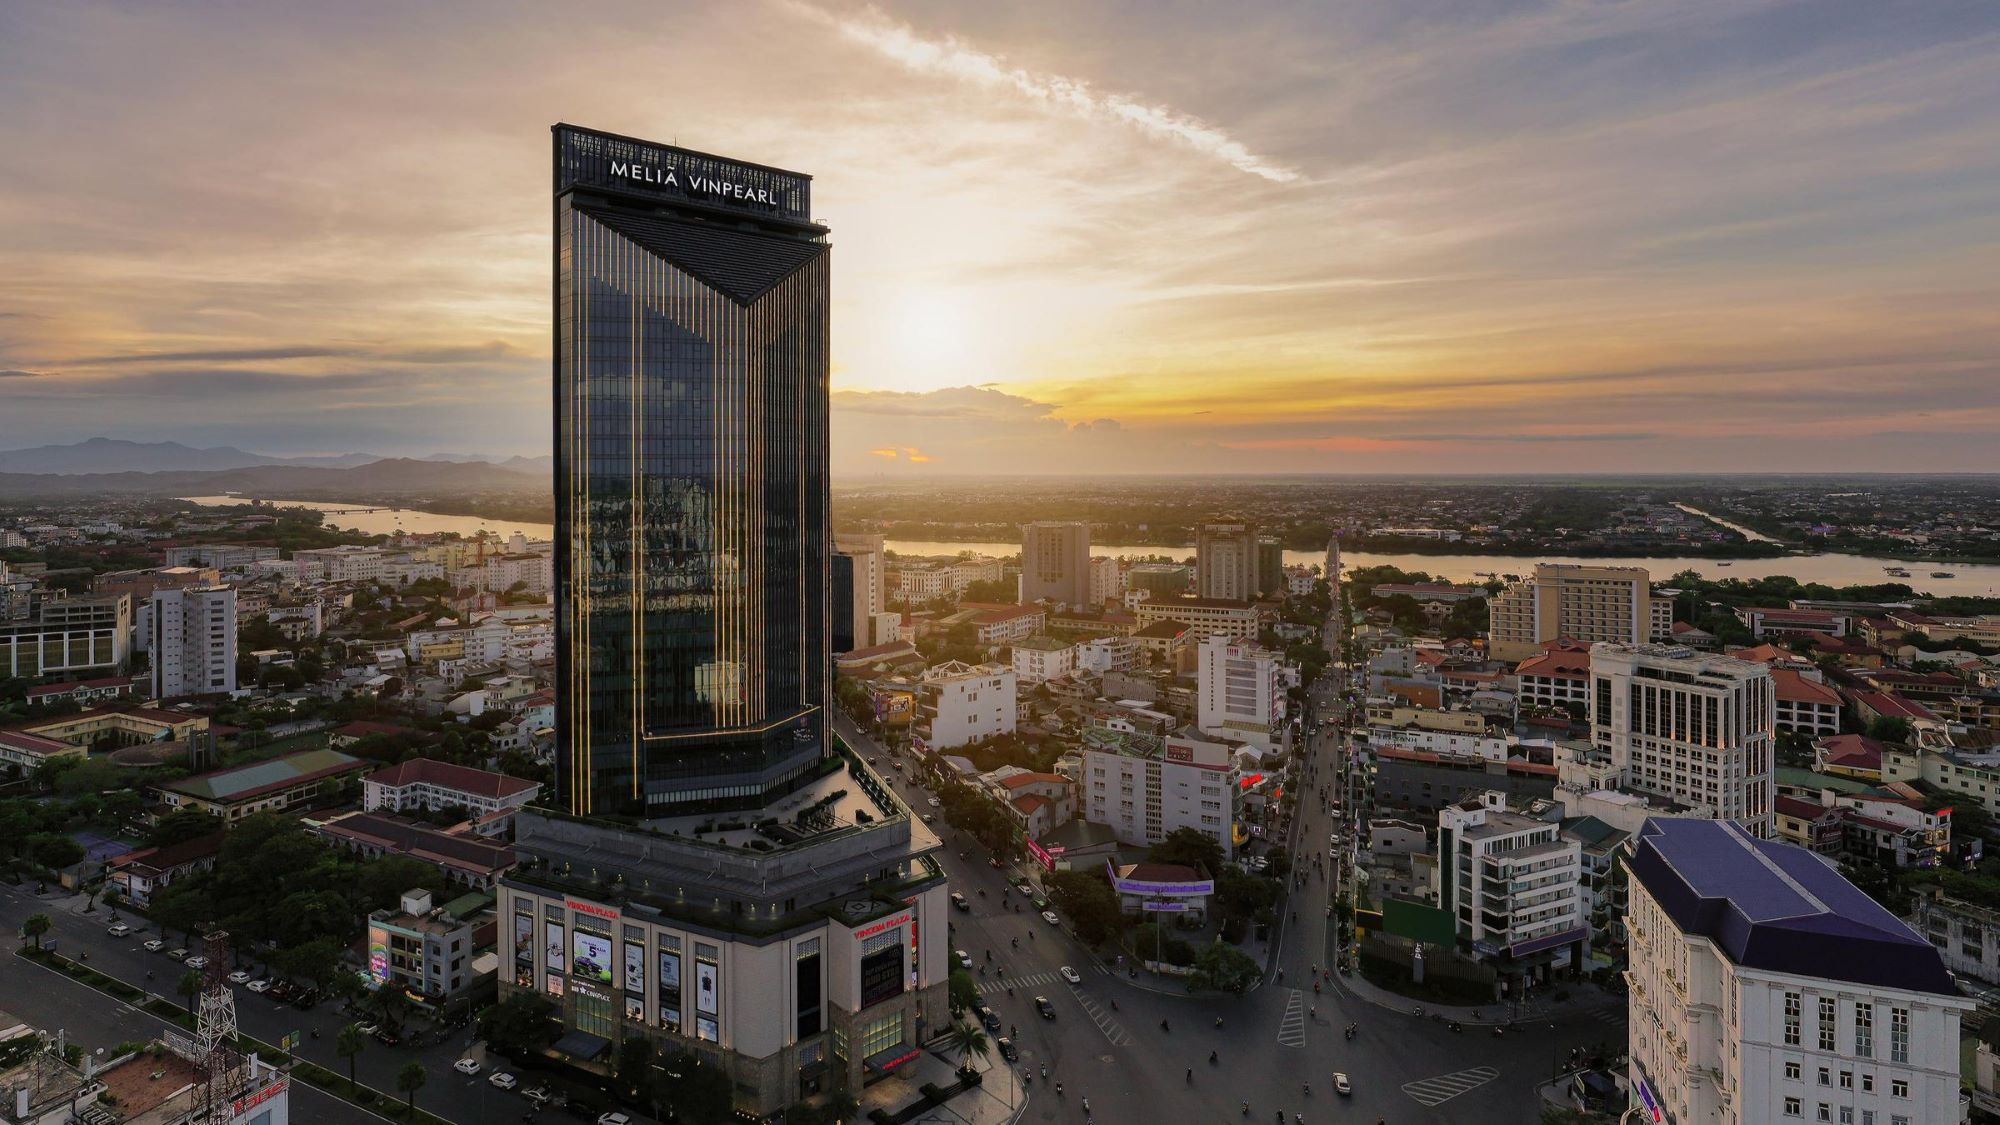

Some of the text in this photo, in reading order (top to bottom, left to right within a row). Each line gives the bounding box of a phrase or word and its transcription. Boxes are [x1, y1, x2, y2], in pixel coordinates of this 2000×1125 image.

[689, 175, 777, 205] VINPEARL
[854, 914, 910, 940] VINCOM PLAZA
